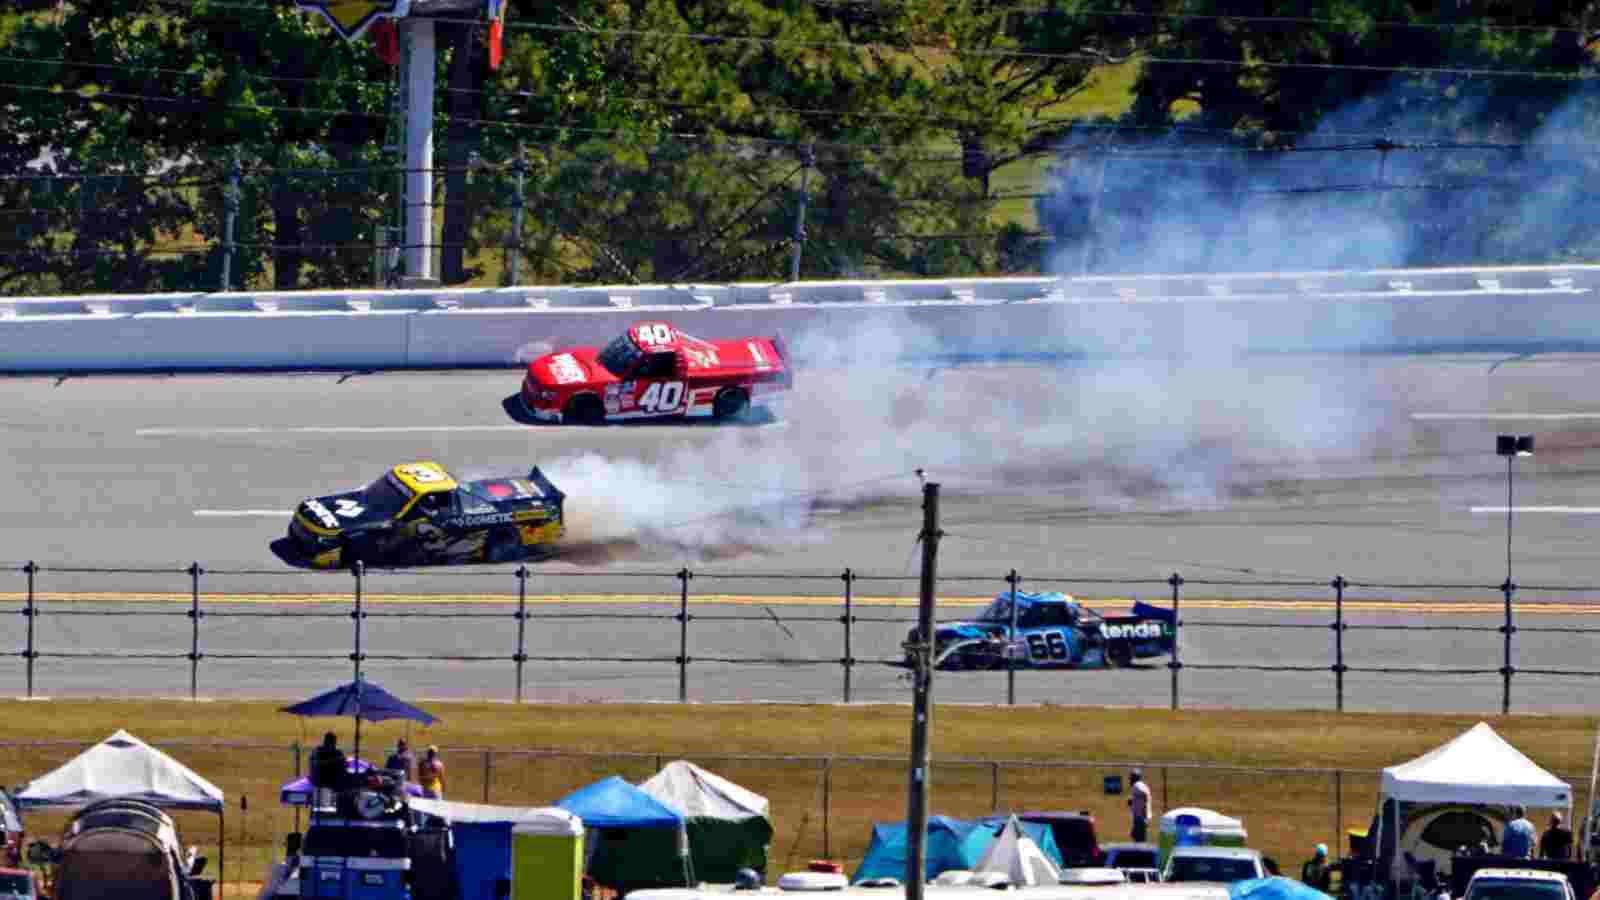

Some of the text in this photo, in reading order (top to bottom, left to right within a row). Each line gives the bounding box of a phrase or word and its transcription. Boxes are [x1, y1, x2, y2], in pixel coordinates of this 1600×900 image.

[638, 325, 673, 345] 40
[639, 381, 684, 412] 40
[1026, 631, 1069, 660] 66
